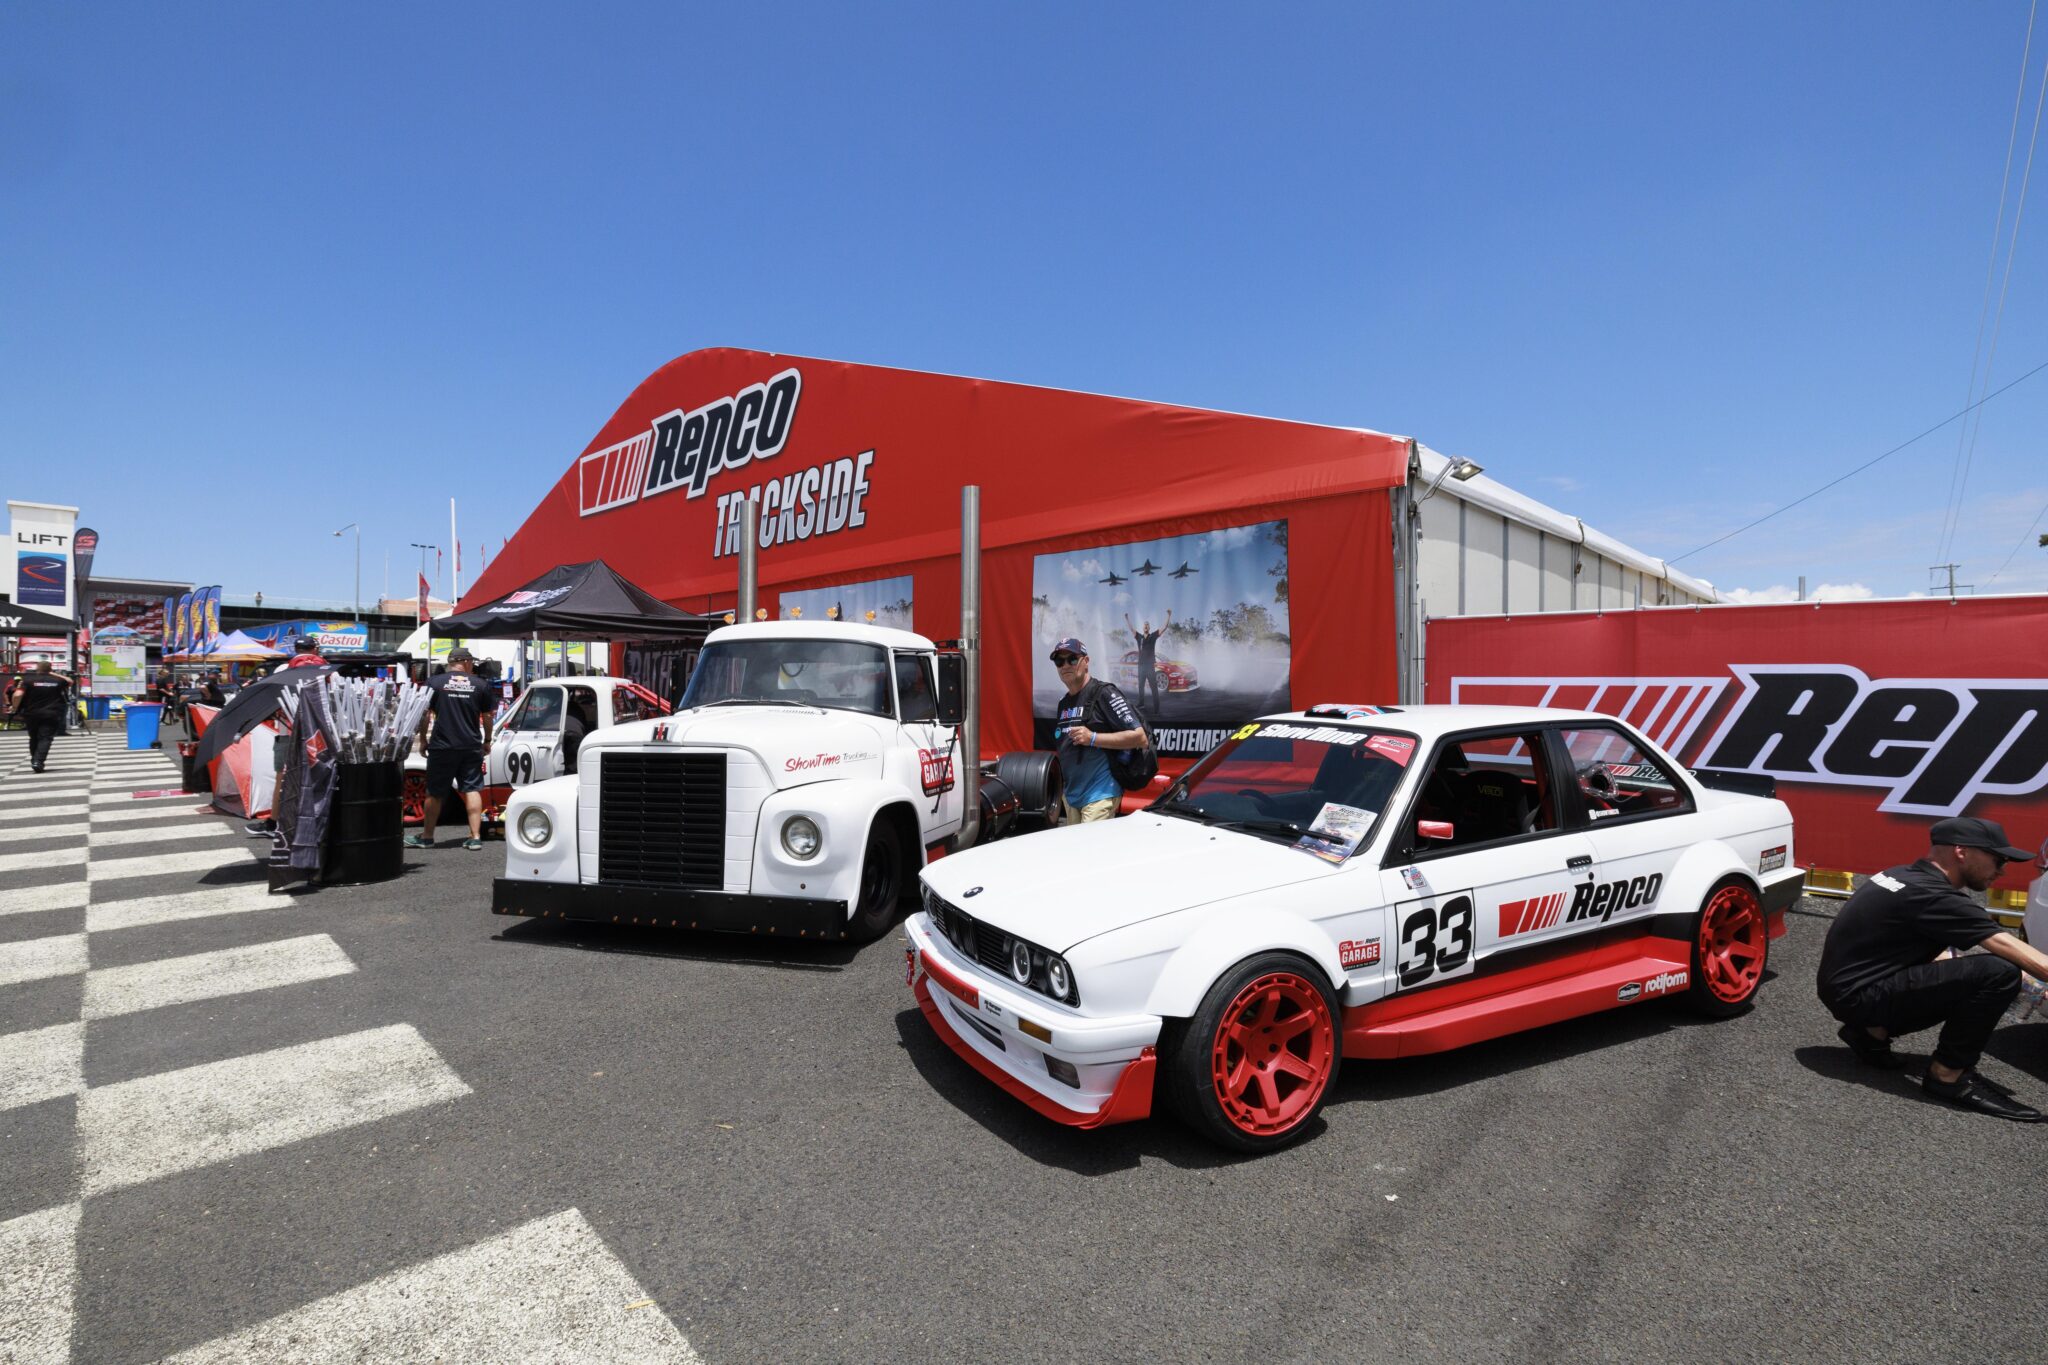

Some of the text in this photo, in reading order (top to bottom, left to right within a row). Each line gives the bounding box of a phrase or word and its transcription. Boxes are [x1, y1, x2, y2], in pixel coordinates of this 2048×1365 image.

[714, 449, 875, 557] TRCKSIDE
[18, 532, 67, 546] LIFT
[320, 634, 362, 646] Castrol
[1154, 728, 1236, 752] XCITEMEN
[1255, 723, 1368, 746] ShowTime
[508, 752, 532, 784] 99
[784, 753, 841, 772] ShowTime
[1399, 895, 1473, 987] 33
[1342, 945, 1378, 963] GARAGE
[1645, 971, 1688, 994] rotiform
